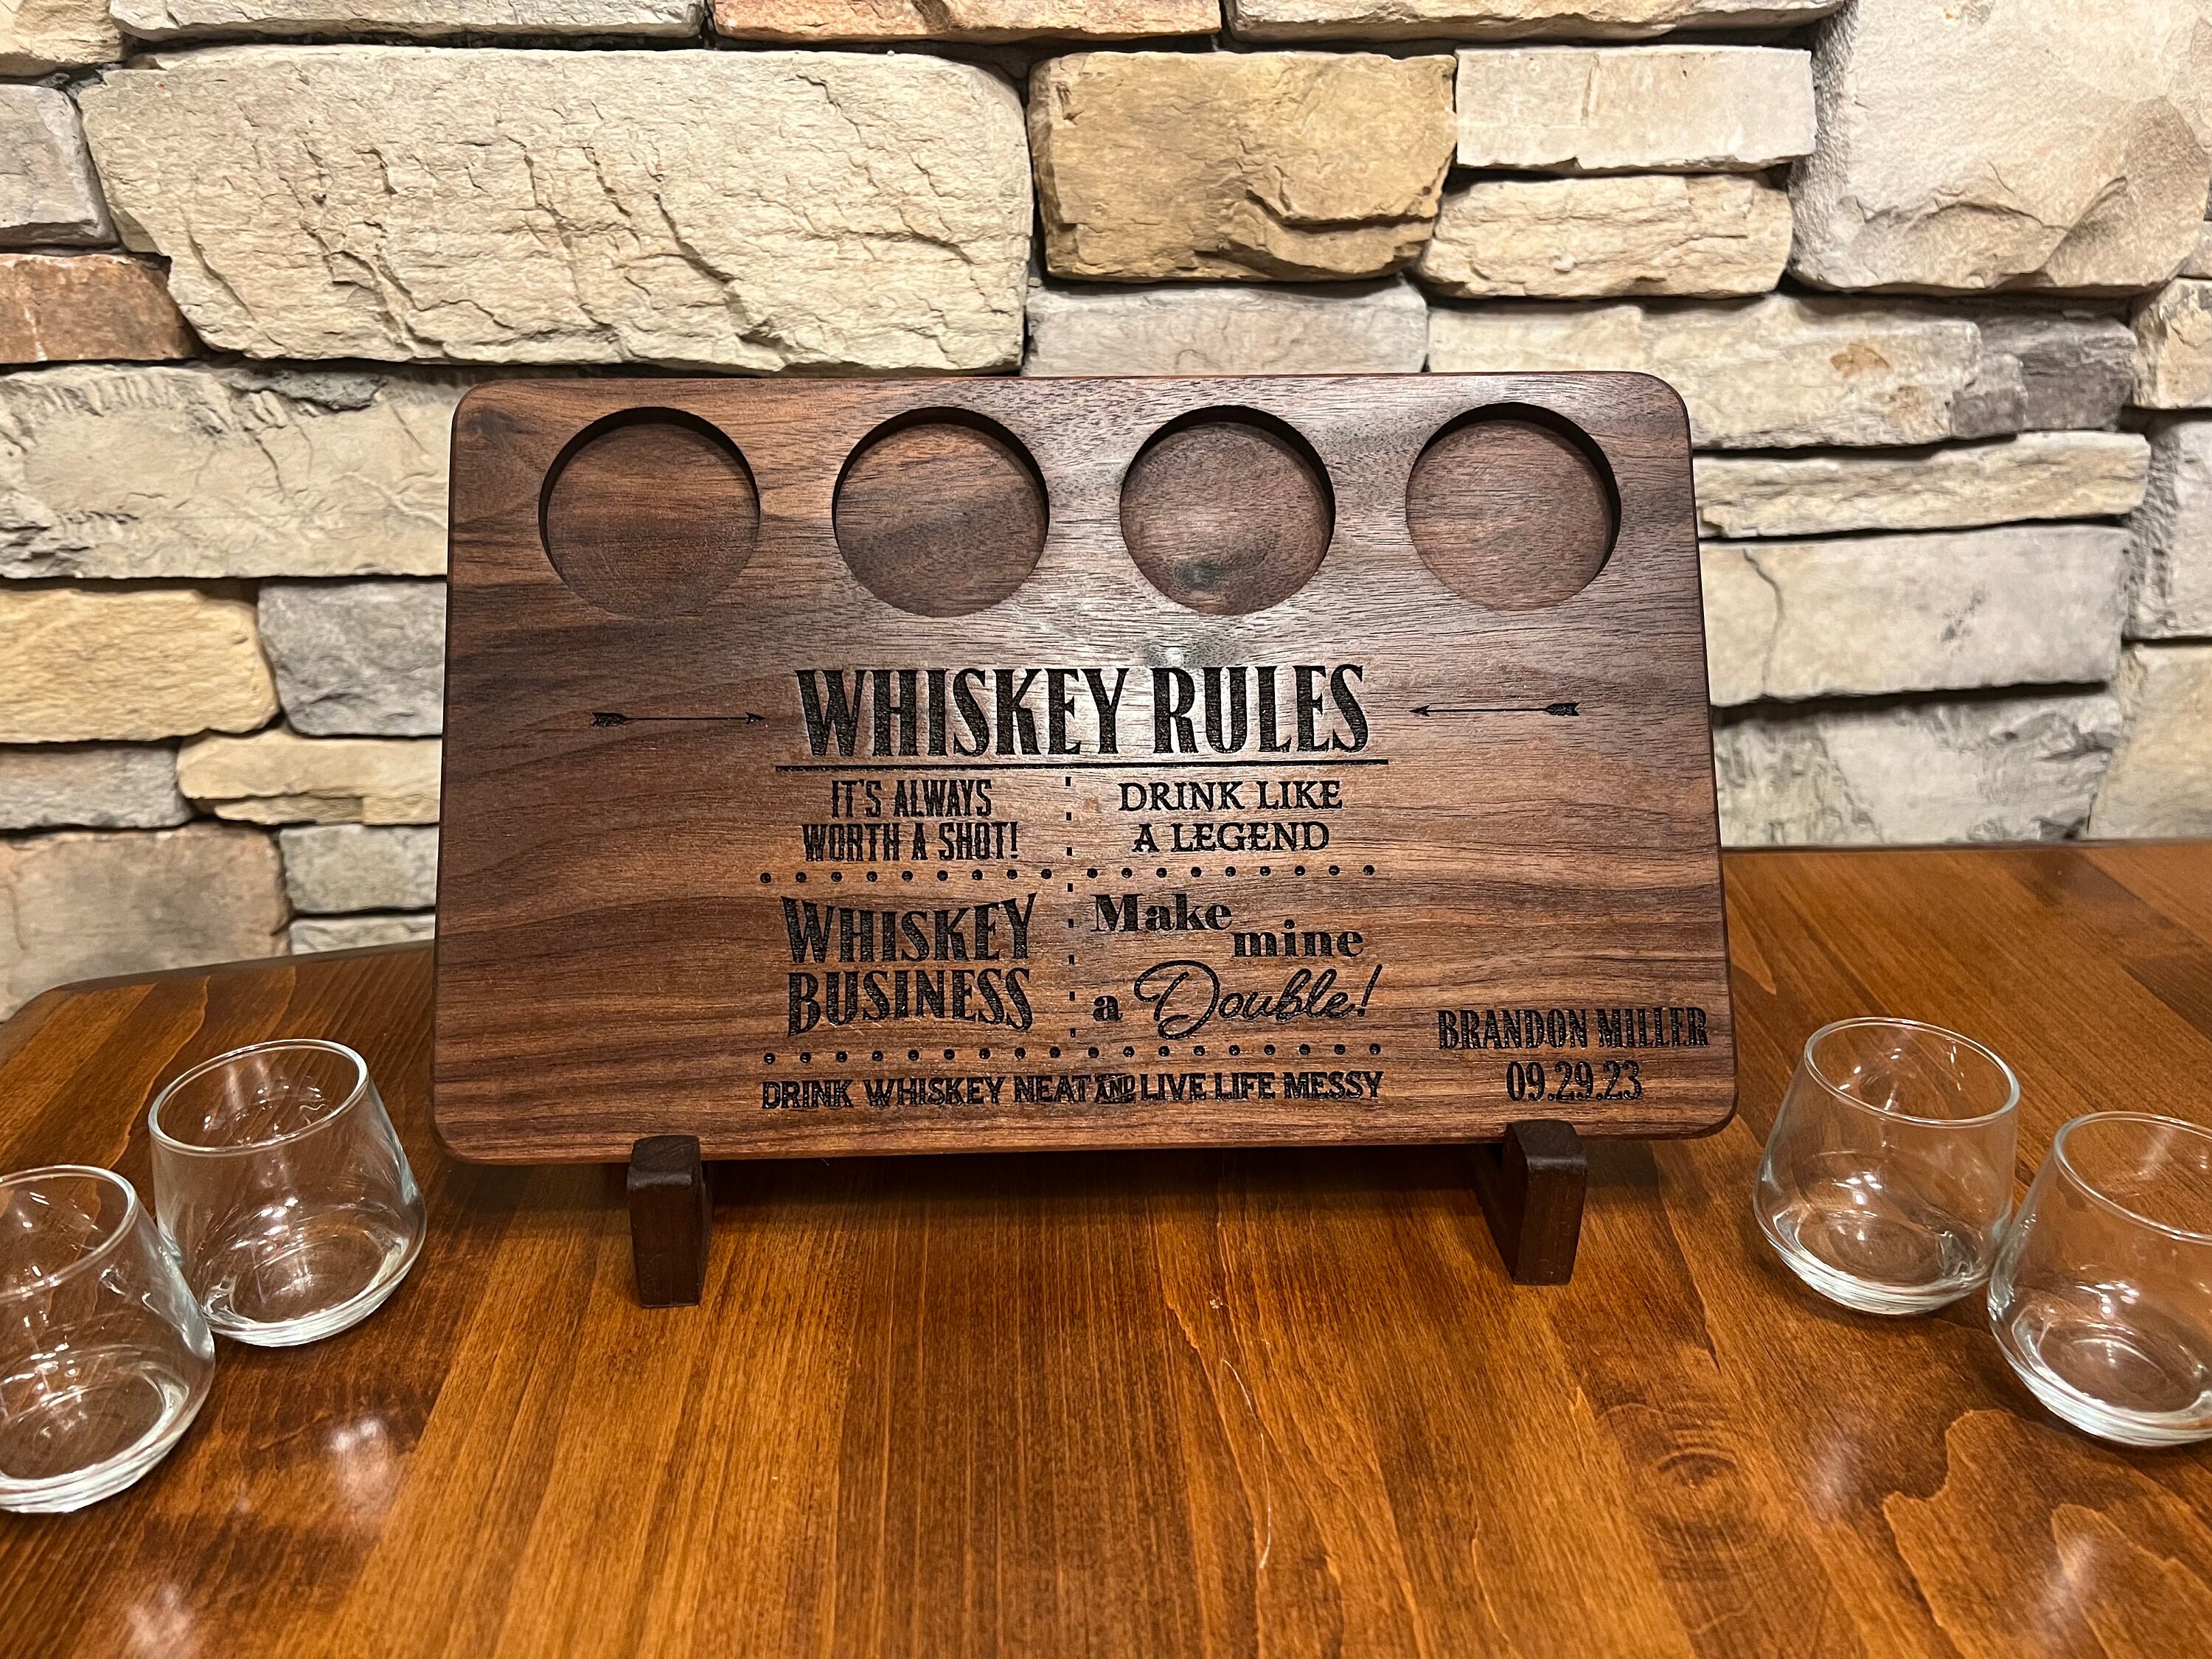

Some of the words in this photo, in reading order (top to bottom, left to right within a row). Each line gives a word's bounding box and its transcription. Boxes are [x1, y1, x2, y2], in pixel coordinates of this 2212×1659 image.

[795, 668, 1128, 757] WHISKEY
[1150, 664, 1369, 754] RULES
[831, 779, 882, 818] IT'S
[893, 779, 992, 817] ALWAYS
[1118, 781, 1245, 811] DRINK
[1256, 780, 1343, 810] LIKE
[801, 823, 900, 862] WORTH
[911, 823, 928, 860] A
[938, 821, 1018, 860] SHOT!
[1132, 823, 1160, 852] A
[1170, 821, 1329, 852] LEGEND
[780, 892, 1037, 964] WHISKEY
[1090, 893, 1232, 932] Make
[1231, 919, 1364, 958] mine
[787, 967, 1034, 1037] BUSINESS
[1092, 995, 1123, 1022] a
[1133, 959, 1383, 1040] Double!
[1437, 1009, 1587, 1049] BRANDON
[1596, 1007, 1710, 1048] MILLER
[761, 1079, 853, 1109] DRINK
[863, 1077, 1006, 1107] WHISKEY
[1014, 1074, 1091, 1104] NEAT
[1094, 1073, 1136, 1105] AND
[1139, 1073, 1206, 1102] LIVE
[1214, 1072, 1276, 1100] LIFE
[1283, 1071, 1384, 1100] MESSY
[1506, 1060, 1643, 1102] 09.29.23
